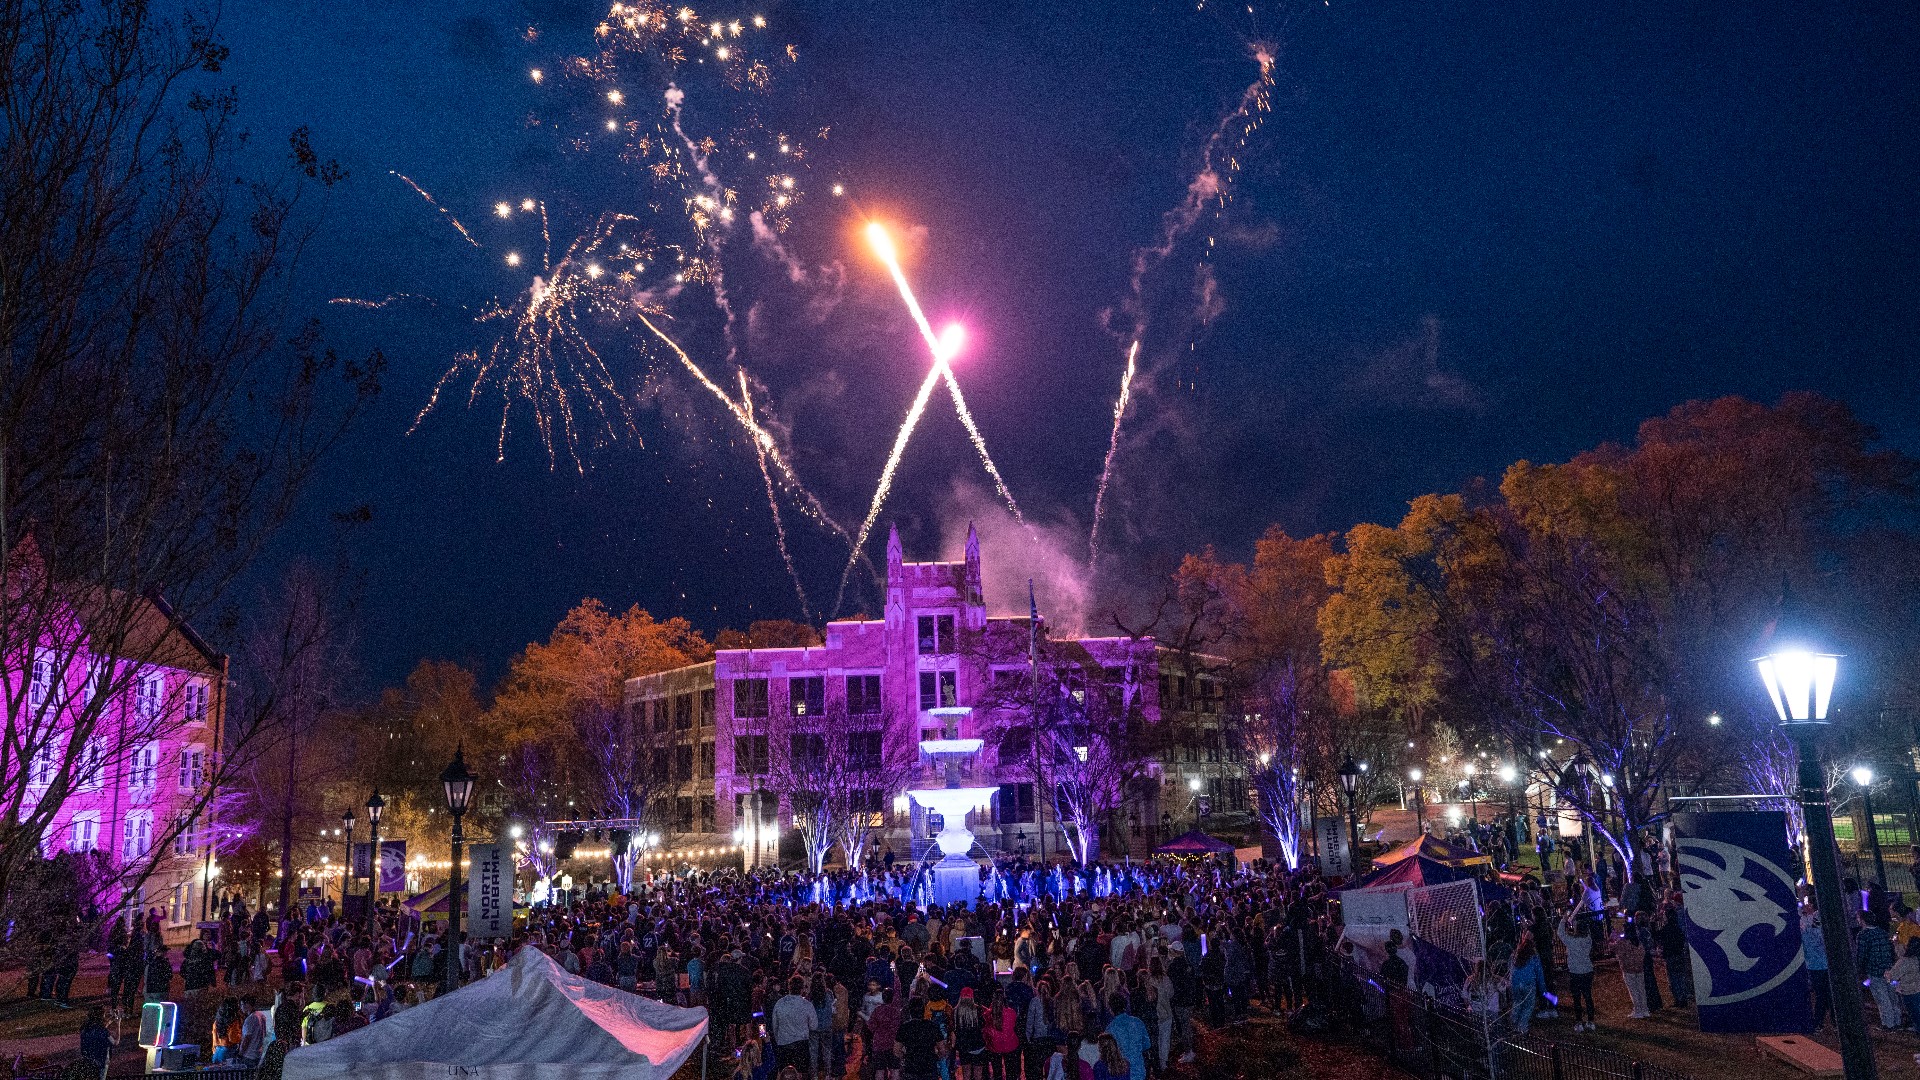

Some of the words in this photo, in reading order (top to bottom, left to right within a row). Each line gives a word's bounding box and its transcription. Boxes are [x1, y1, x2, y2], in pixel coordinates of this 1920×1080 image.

[1326, 828, 1335, 865] NORTH
[481, 861, 491, 919] NORTH
[490, 849, 500, 931] ALABAMA
[644, 937, 653, 948] 22
[782, 941, 793, 952] 22
[448, 1065, 479, 1076] UNA
